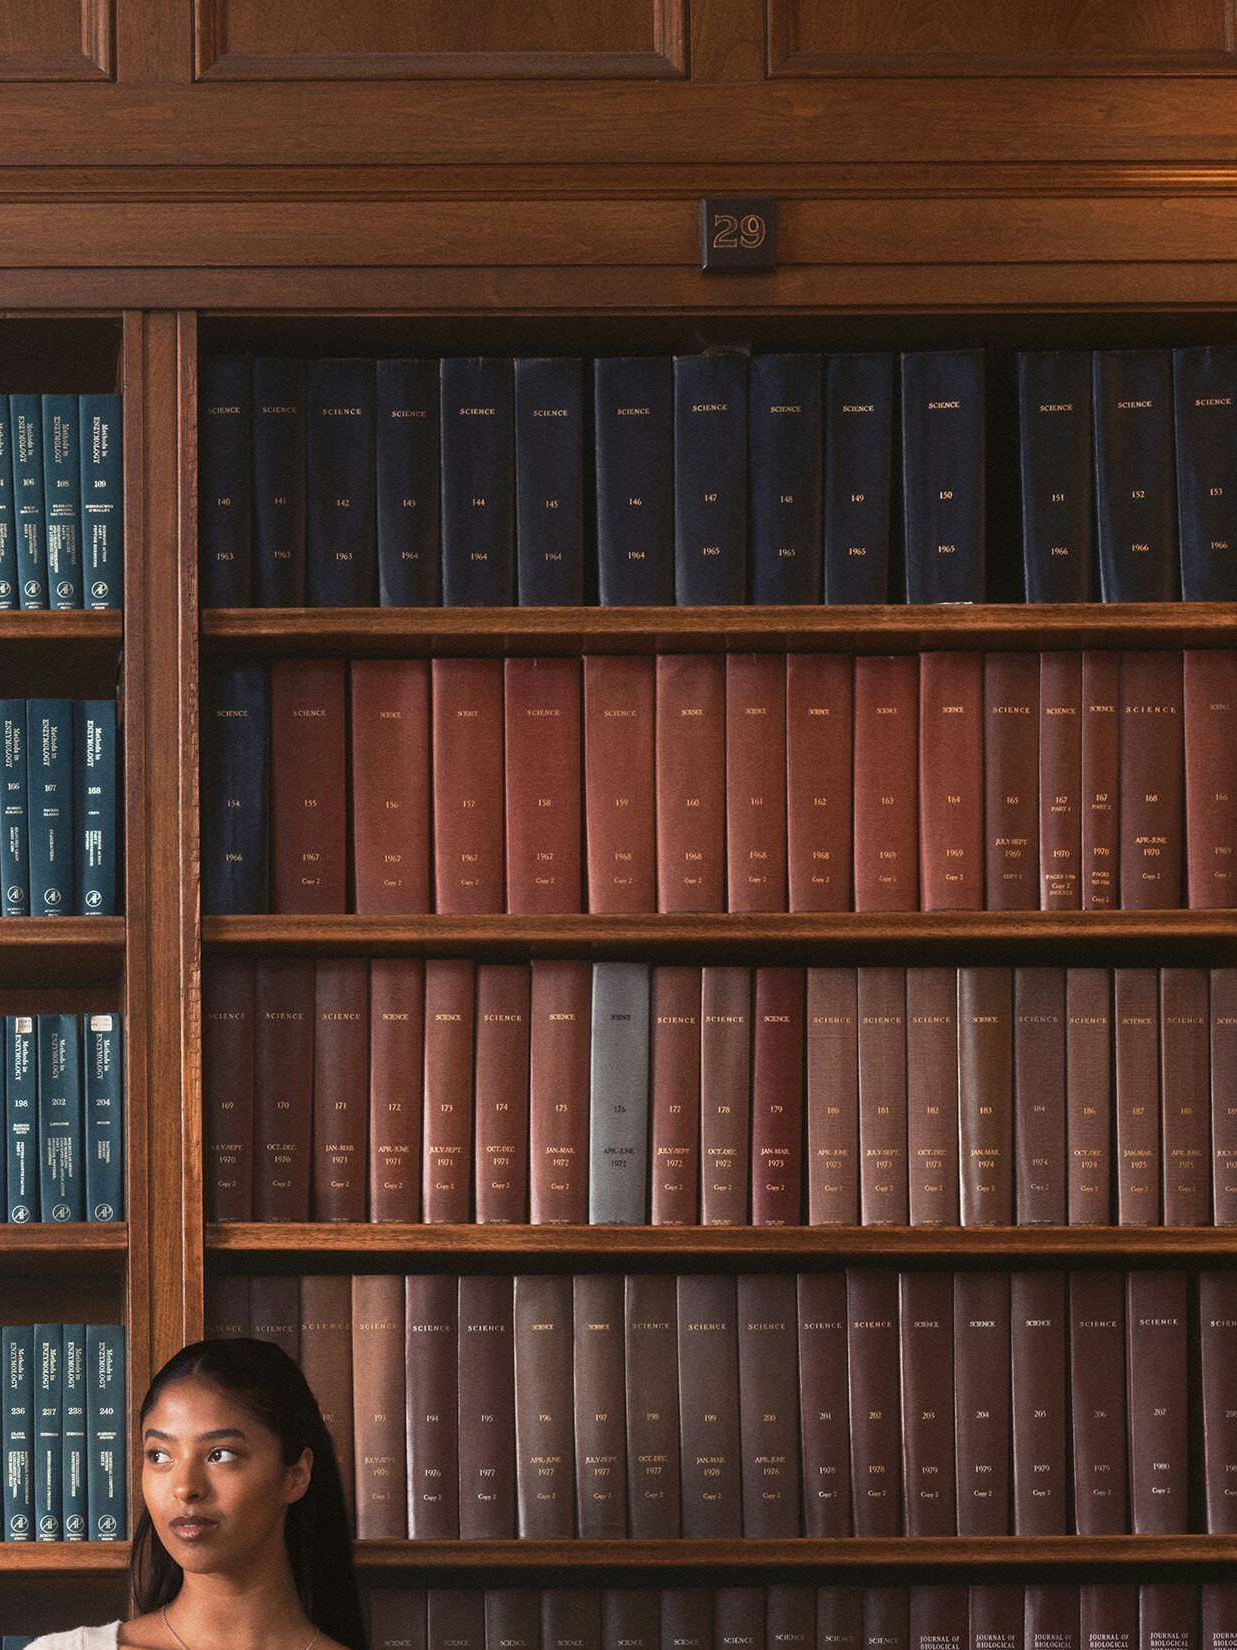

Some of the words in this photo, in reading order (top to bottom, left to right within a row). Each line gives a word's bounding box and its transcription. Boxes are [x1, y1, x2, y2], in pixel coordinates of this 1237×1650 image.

[714, 215, 765, 248] 29
[939, 491, 953, 499] 150
[1143, 848, 1160, 856] 1970
[484, 1014, 521, 1022] SCIENCE
